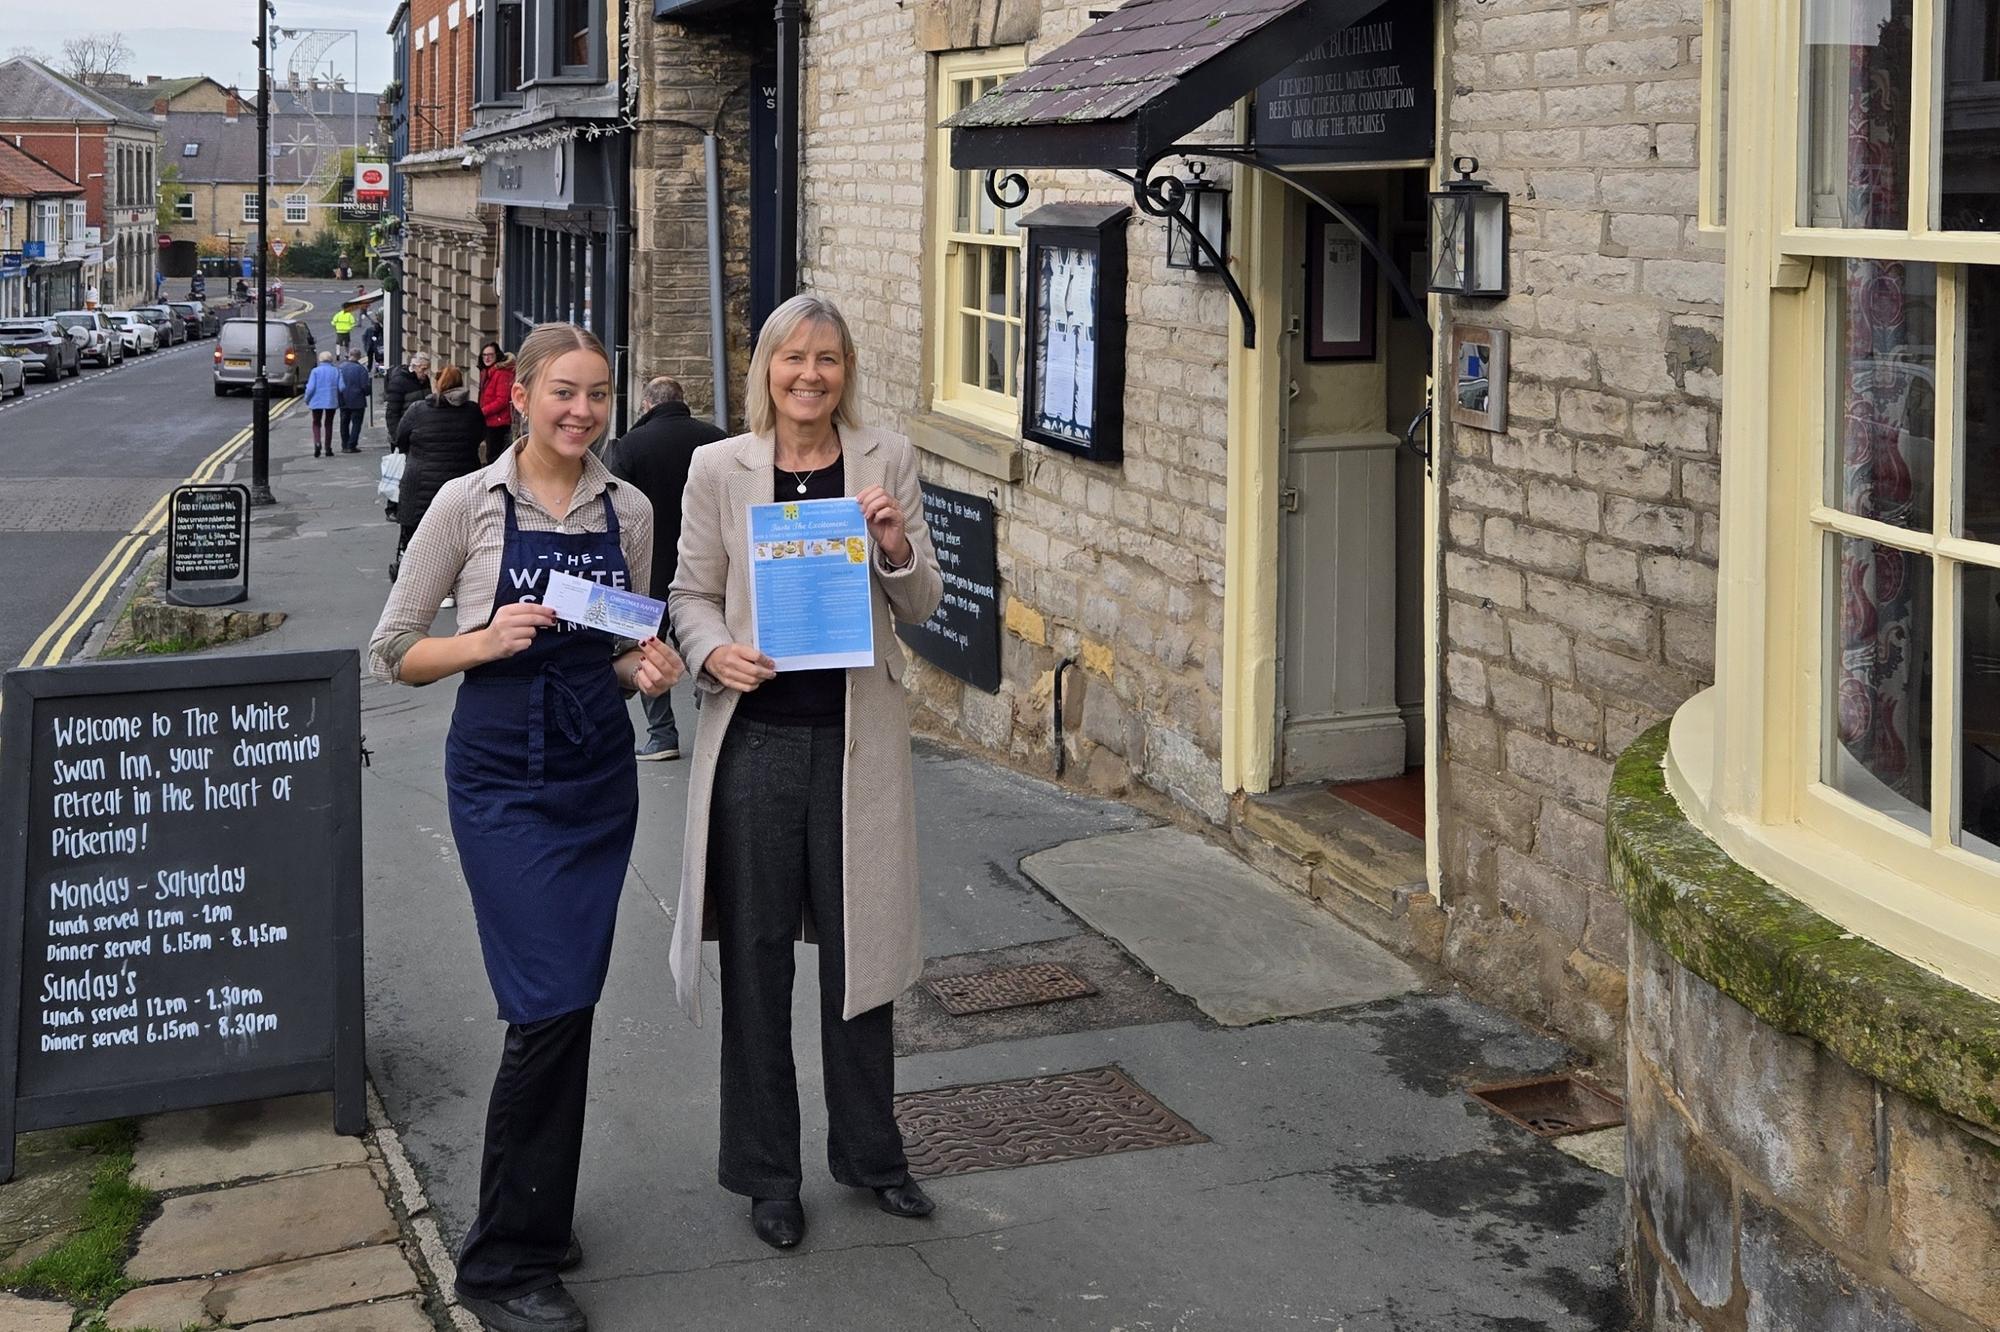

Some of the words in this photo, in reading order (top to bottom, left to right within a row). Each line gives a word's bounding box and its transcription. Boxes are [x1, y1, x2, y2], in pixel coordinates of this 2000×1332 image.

[1329, 21, 1393, 58] BUCHANAN
[1314, 75, 1324, 94] TO
[1325, 72, 1344, 93] SELL
[1268, 100, 1292, 120] BEERS
[1294, 97, 1310, 118] AND
[1311, 95, 1340, 116] CIDERS
[1341, 93, 1357, 113] FOR
[1358, 87, 1415, 112] CONSUMPTION
[1291, 120, 1302, 139] ON
[1303, 119, 1315, 138] OR
[1316, 117, 1329, 137] OFF
[1331, 115, 1346, 136] THE
[1347, 113, 1386, 135] PREMISES
[508, 568, 625, 590] WTE
[54, 716, 142, 748] Welcome
[152, 711, 171, 738] to
[182, 707, 219, 737] The
[231, 701, 290, 732] White
[169, 747, 214, 773] your
[232, 733, 320, 767] charming
[53, 788, 123, 818] retreat
[133, 786, 151, 816] in
[162, 782, 194, 813] the
[204, 776, 262, 811] heart
[52, 822, 147, 859] Pickering!
[50, 876, 129, 911] Monday
[155, 864, 246, 900] Saturday
[48, 914, 89, 936] Lunch
[93, 907, 139, 932] served
[147, 908, 184, 930] 12pm
[46, 942, 99, 962] Dinner
[103, 935, 151, 959] served
[162, 931, 212, 954] 6.15pm
[231, 922, 288, 948] 8.45pm
[39, 961, 137, 1003] Sunday's
[42, 1006, 85, 1027] Lunch
[90, 998, 138, 1025] served
[146, 996, 188, 1017] 12pm
[206, 985, 263, 1011] 2.30pm
[41, 1033, 87, 1052] Dinner
[92, 1025, 139, 1048] served
[146, 1019, 199, 1043] 6.15pm
[218, 1012, 278, 1037] 8.30pm
